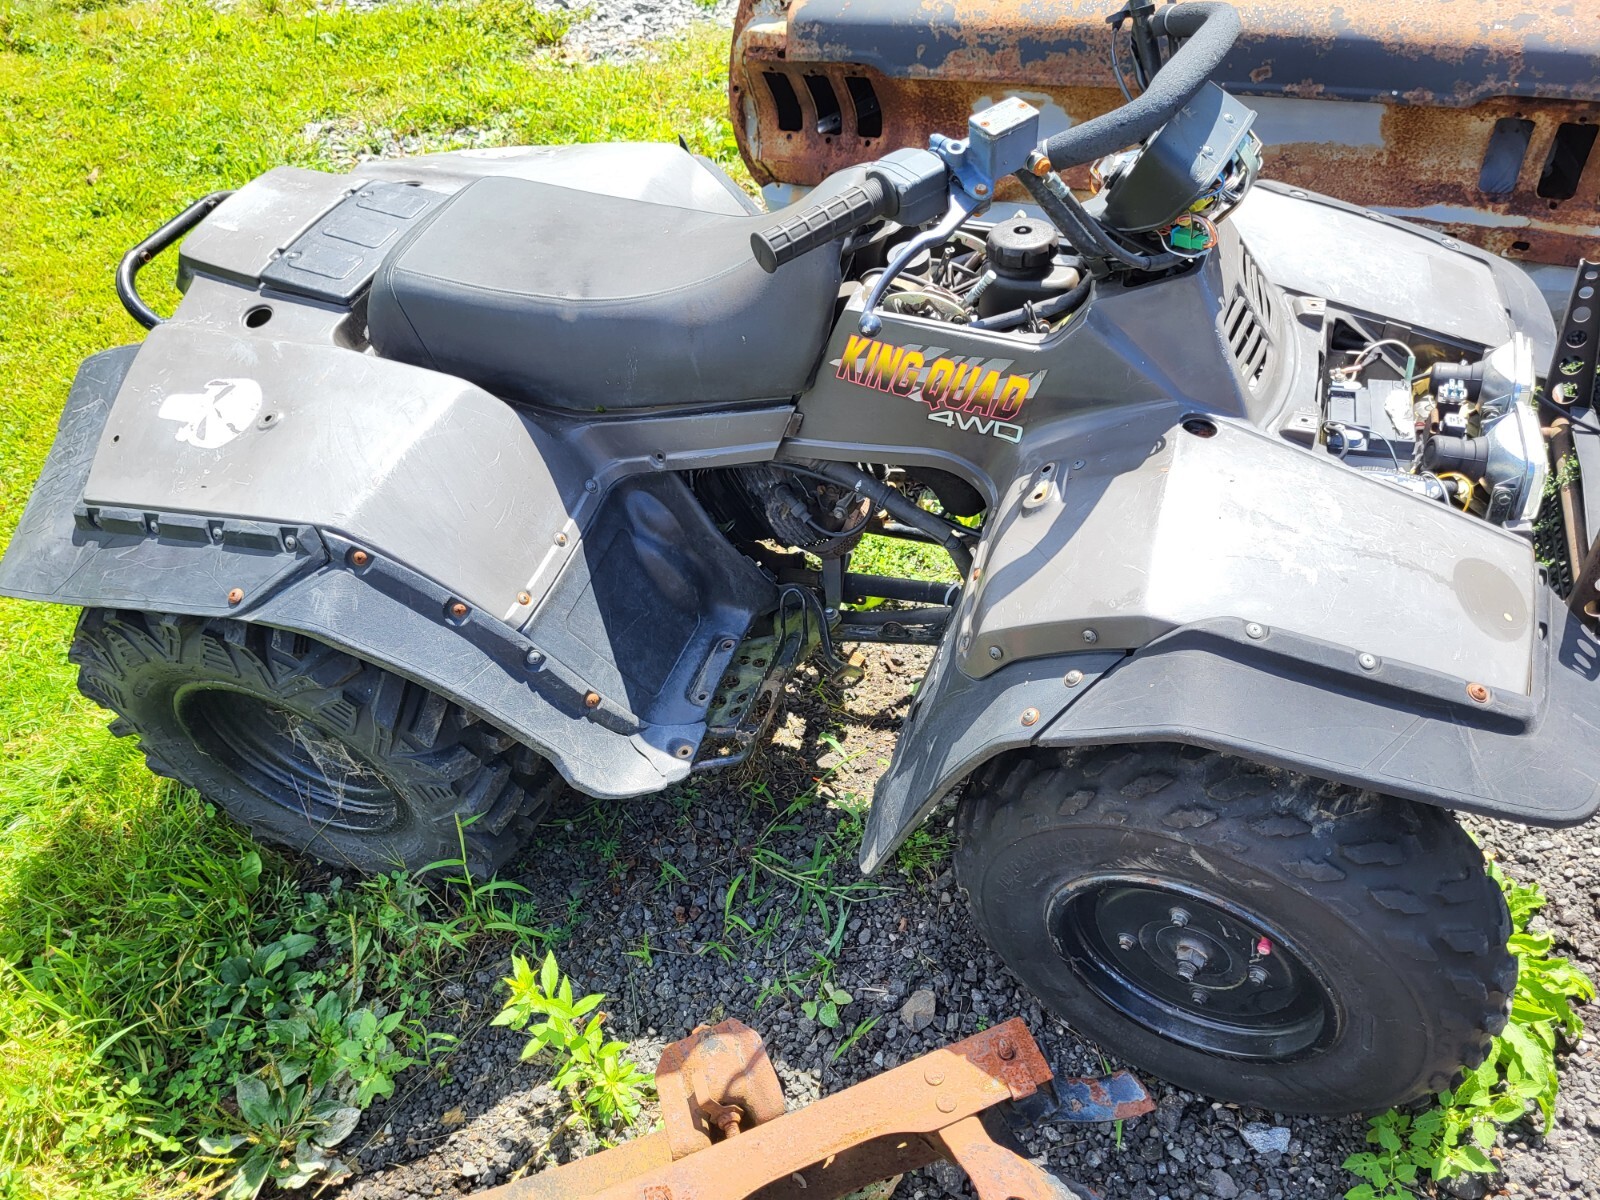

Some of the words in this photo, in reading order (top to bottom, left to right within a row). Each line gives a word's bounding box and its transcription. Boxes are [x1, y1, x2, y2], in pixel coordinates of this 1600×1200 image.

[835, 334, 925, 398] KING
[920, 357, 1030, 421] QUAD
[927, 410, 1024, 445] 4WD
